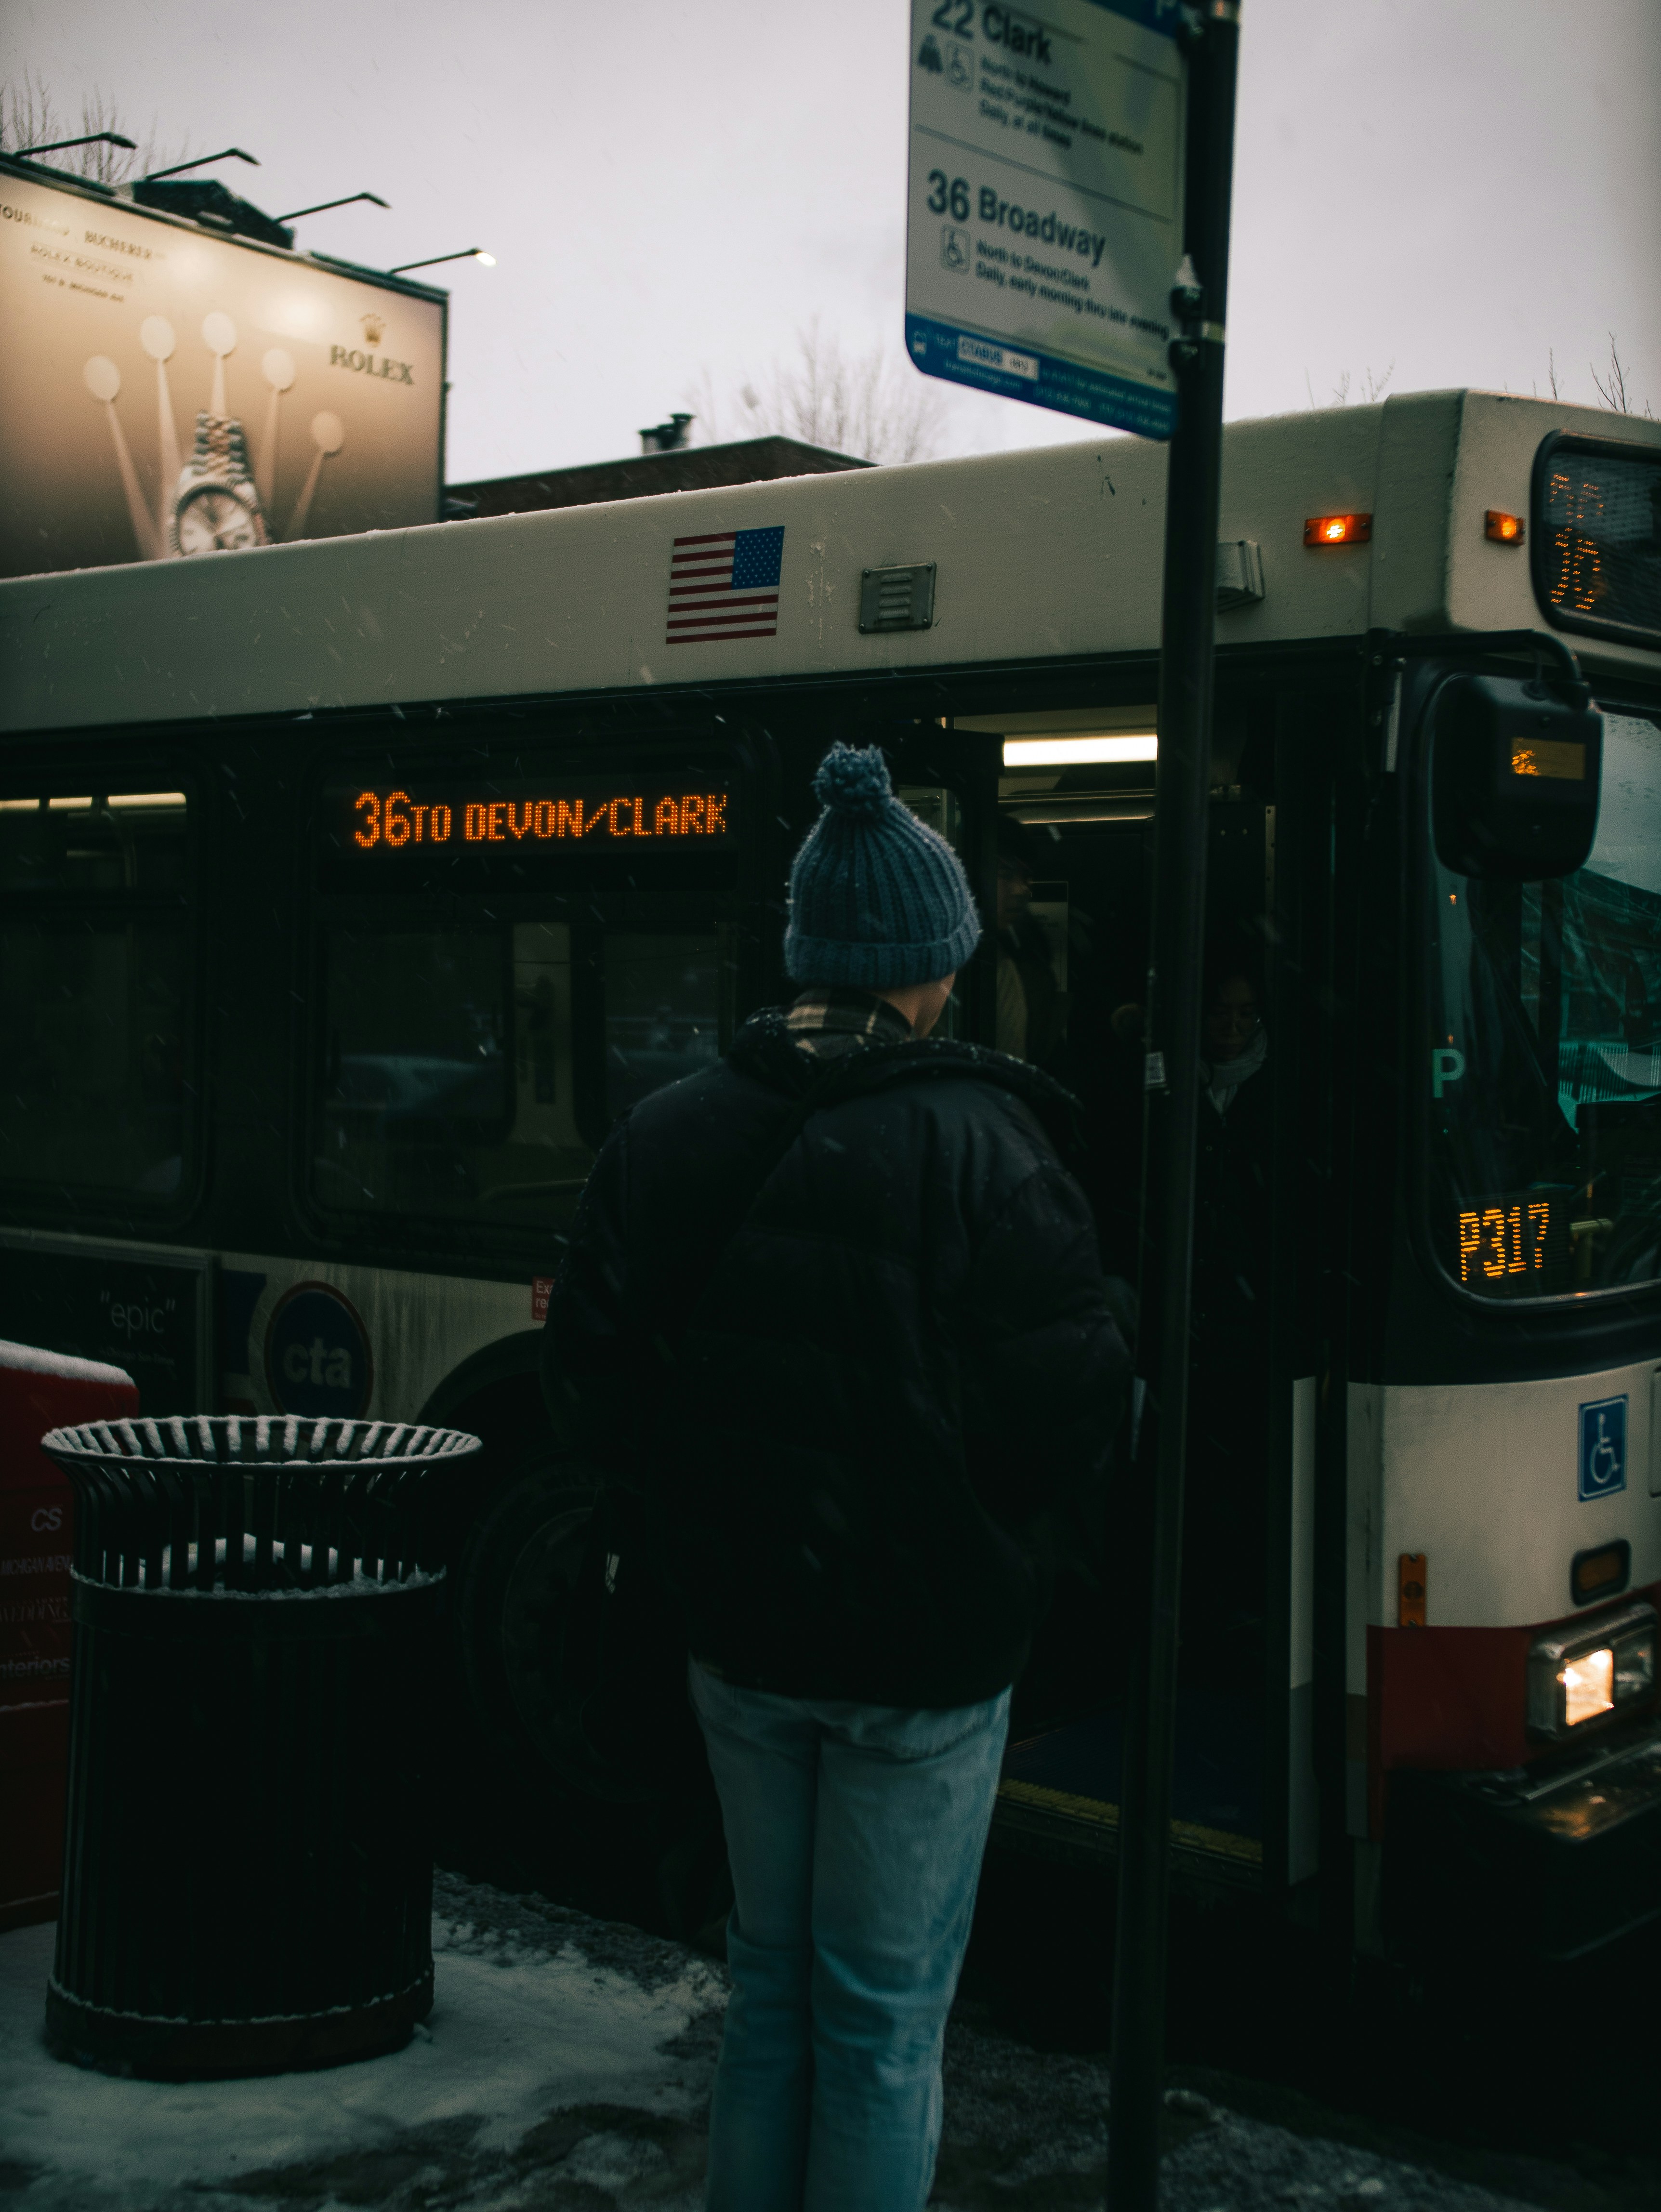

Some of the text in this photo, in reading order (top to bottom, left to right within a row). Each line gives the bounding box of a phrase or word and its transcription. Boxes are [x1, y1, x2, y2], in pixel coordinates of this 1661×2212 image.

[933, 0, 1052, 65] 22 Clark
[927, 169, 1106, 267] 36 Broadway
[976, 240, 1007, 263] North
[1010, 251, 1023, 267] to
[1010, 276, 1037, 299] early
[1039, 285, 1084, 313] morning
[1129, 316, 1171, 341] evening
[330, 344, 415, 386] ROLEX
[355, 791, 728, 848] 36 TO DEVON/CLARK
[1460, 1203, 1549, 1281] P317
[100, 1289, 176, 1341] "epic"
[283, 1336, 353, 1389] cta
[31, 1507, 63, 1532] CS
